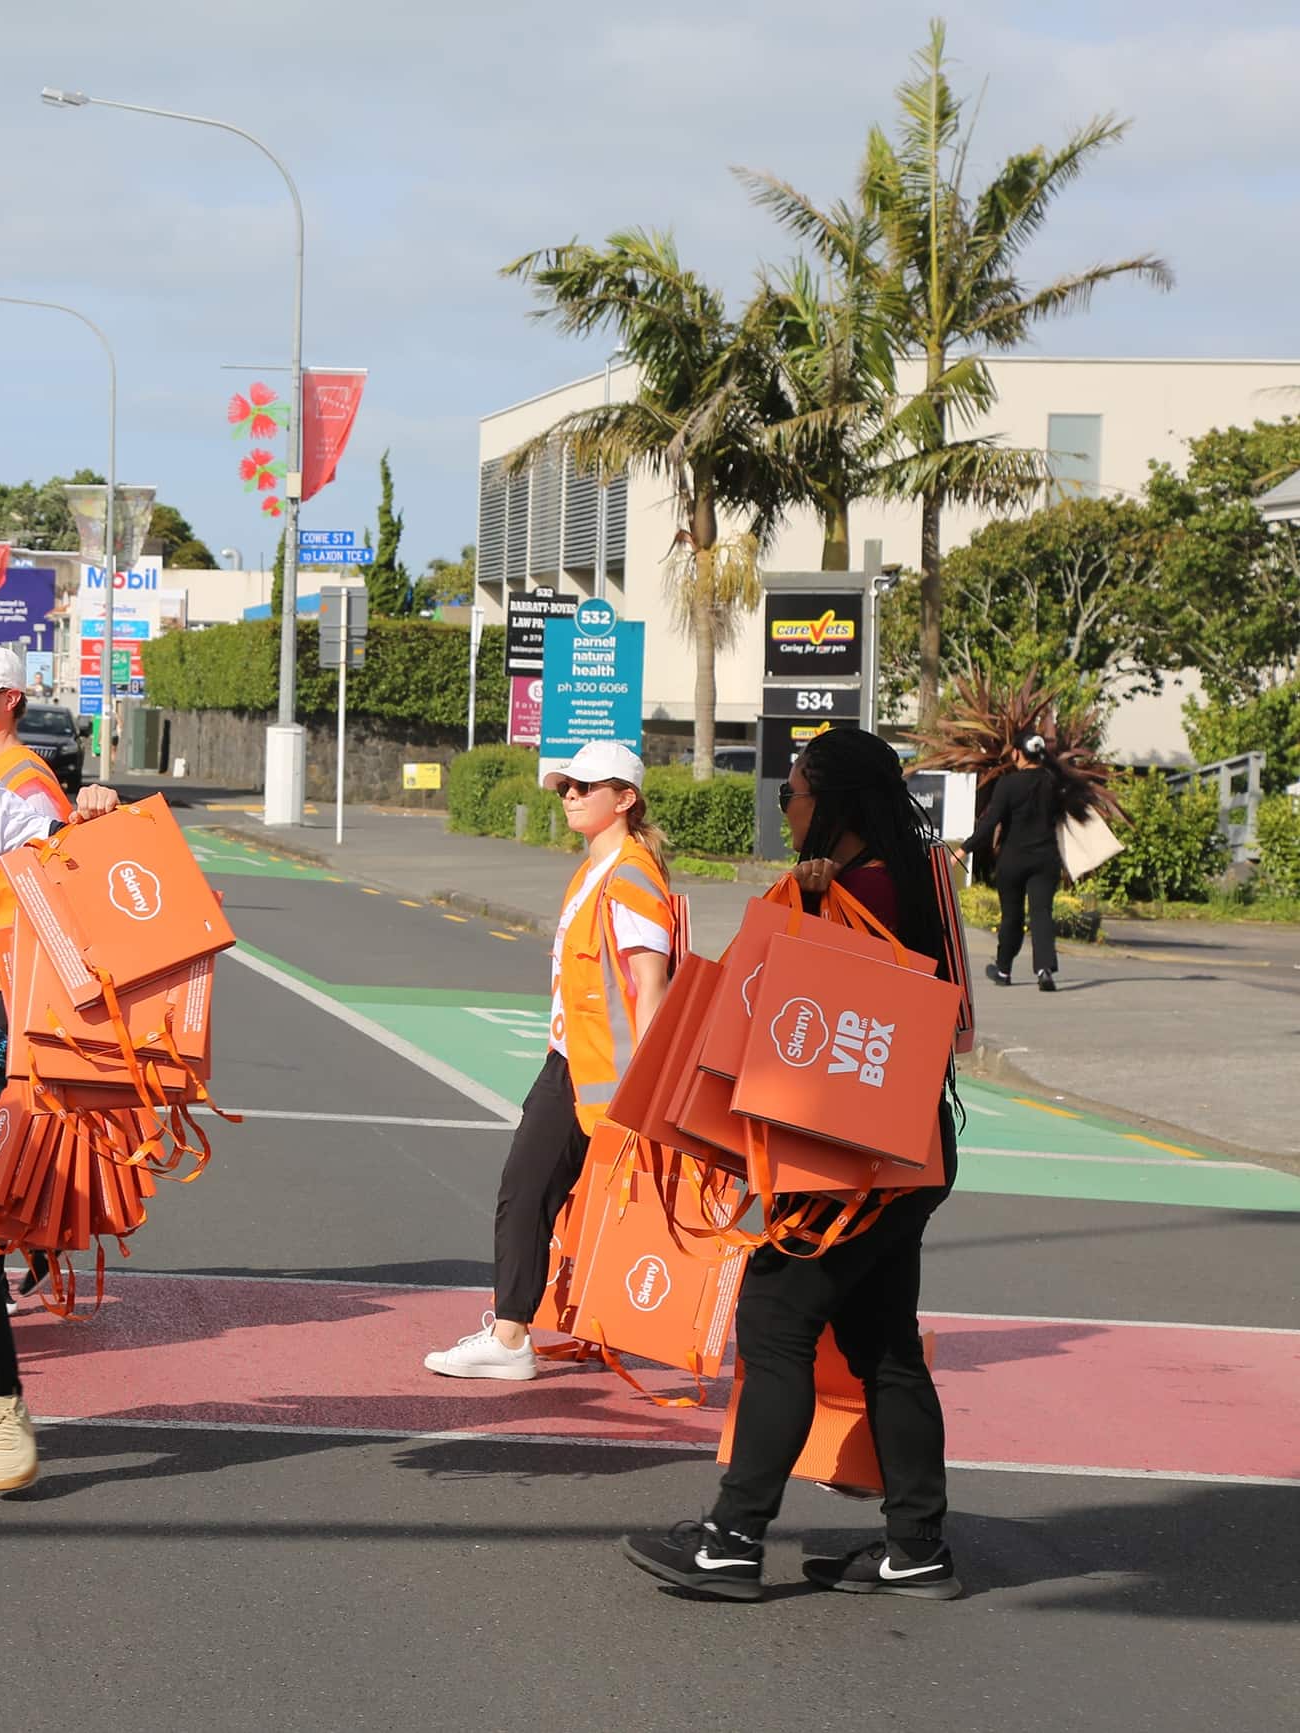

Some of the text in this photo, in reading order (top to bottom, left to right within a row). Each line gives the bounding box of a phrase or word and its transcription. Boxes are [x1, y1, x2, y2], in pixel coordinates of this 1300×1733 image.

[332, 533, 345, 544] ST
[313, 551, 343, 561] LAXON
[346, 551, 363, 561] TCE
[87, 566, 157, 590] Mobil
[512, 617, 531, 629] LAW
[581, 610, 611, 625] 532
[573, 636, 617, 650] parnell
[780, 644, 804, 654] Caring
[804, 644, 815, 654] for
[831, 645, 847, 654] pets
[572, 650, 616, 663] natural
[572, 663, 616, 677] health
[557, 682, 572, 694] ph
[573, 682, 597, 693] 300
[599, 683, 629, 695] 6066
[571, 699, 615, 708] osteopathy
[796, 691, 834, 711] 534
[575, 709, 609, 718] massage
[568, 718, 615, 728] naturopathy
[568, 728, 616, 737] acupuncture
[119, 867, 150, 913] Skinny
[786, 1005, 814, 1059] Skinny
[827, 1010, 869, 1074] VIP ish
[859, 1017, 896, 1088] BOX
[636, 1261, 660, 1305] Skinny
